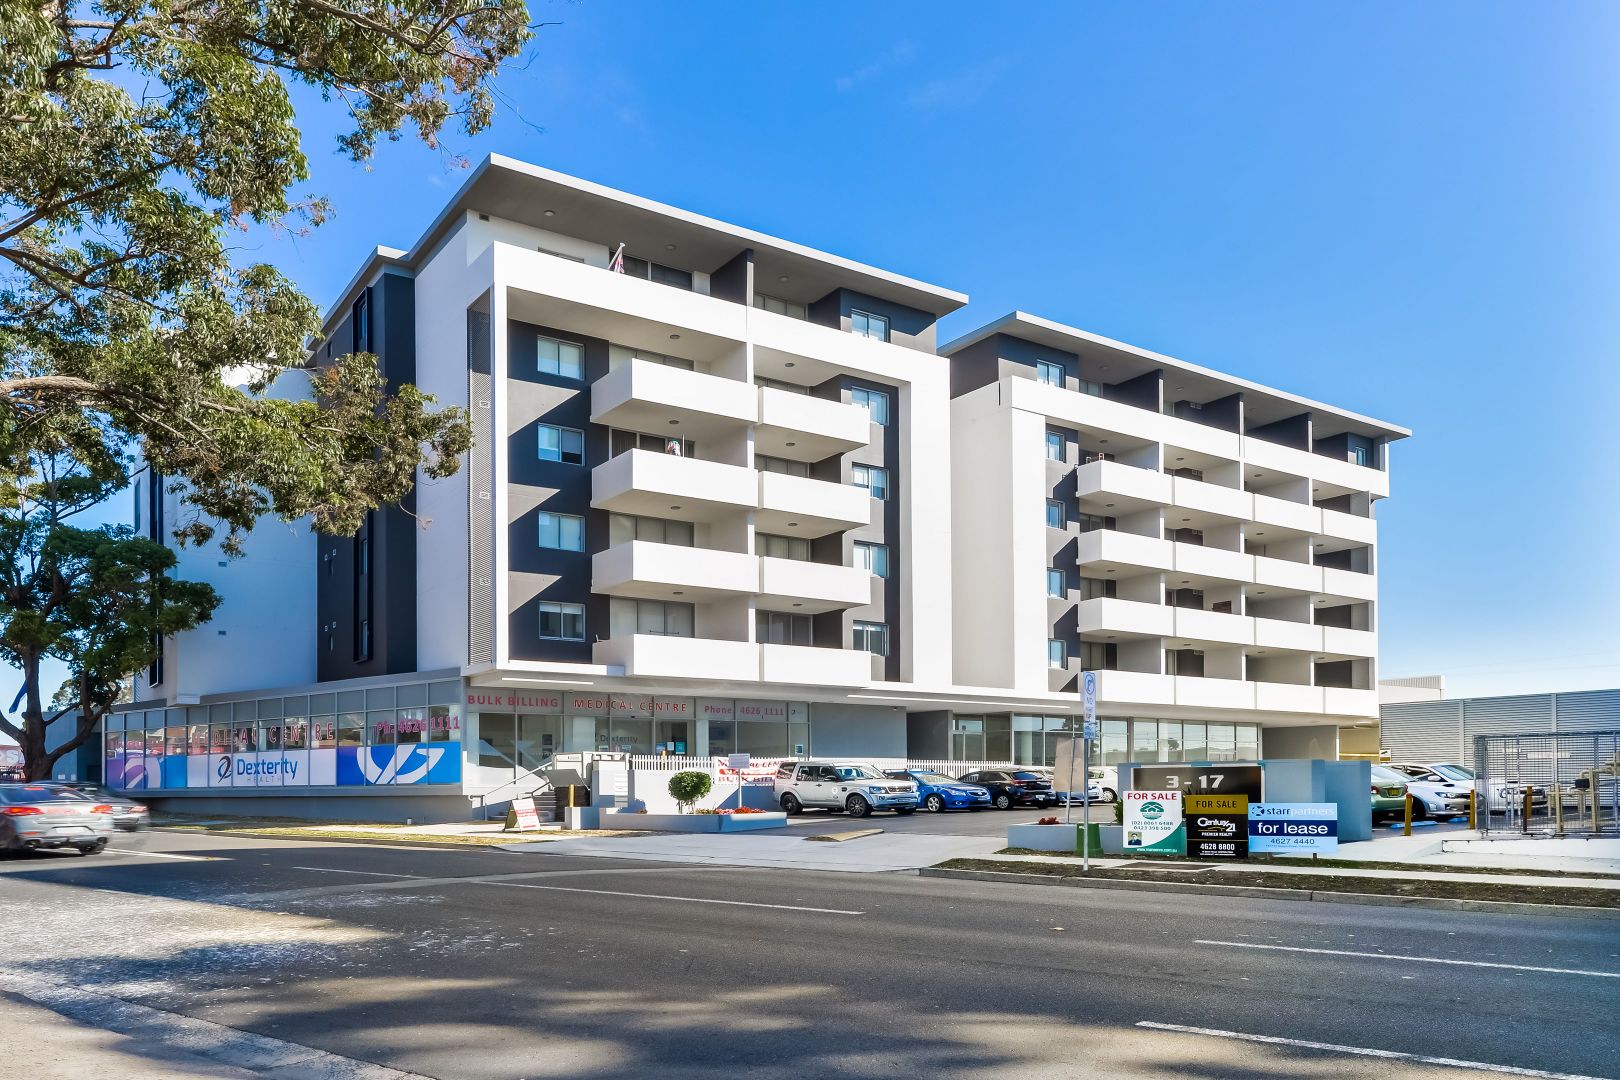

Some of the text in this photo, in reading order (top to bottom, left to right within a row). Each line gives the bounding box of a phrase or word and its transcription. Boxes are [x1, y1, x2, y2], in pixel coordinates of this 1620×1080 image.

[467, 695, 559, 708] BULK BILLING
[574, 699, 687, 712] MEDICAL CENTRE
[764, 707, 785, 716] 1111
[398, 719, 427, 734] 4626
[430, 715, 461, 732] 1111
[268, 721, 335, 744] CENTRE
[237, 757, 299, 780] Dexterity
[1166, 775, 1179, 789] 3
[1198, 774, 1224, 789] 17
[1127, 792, 1178, 800] FOR SALE
[1196, 800, 1237, 808] FOR SALE
[1225, 823, 1236, 832] 21
[1257, 822, 1329, 835] for lease
[1218, 843, 1235, 851] 8800
